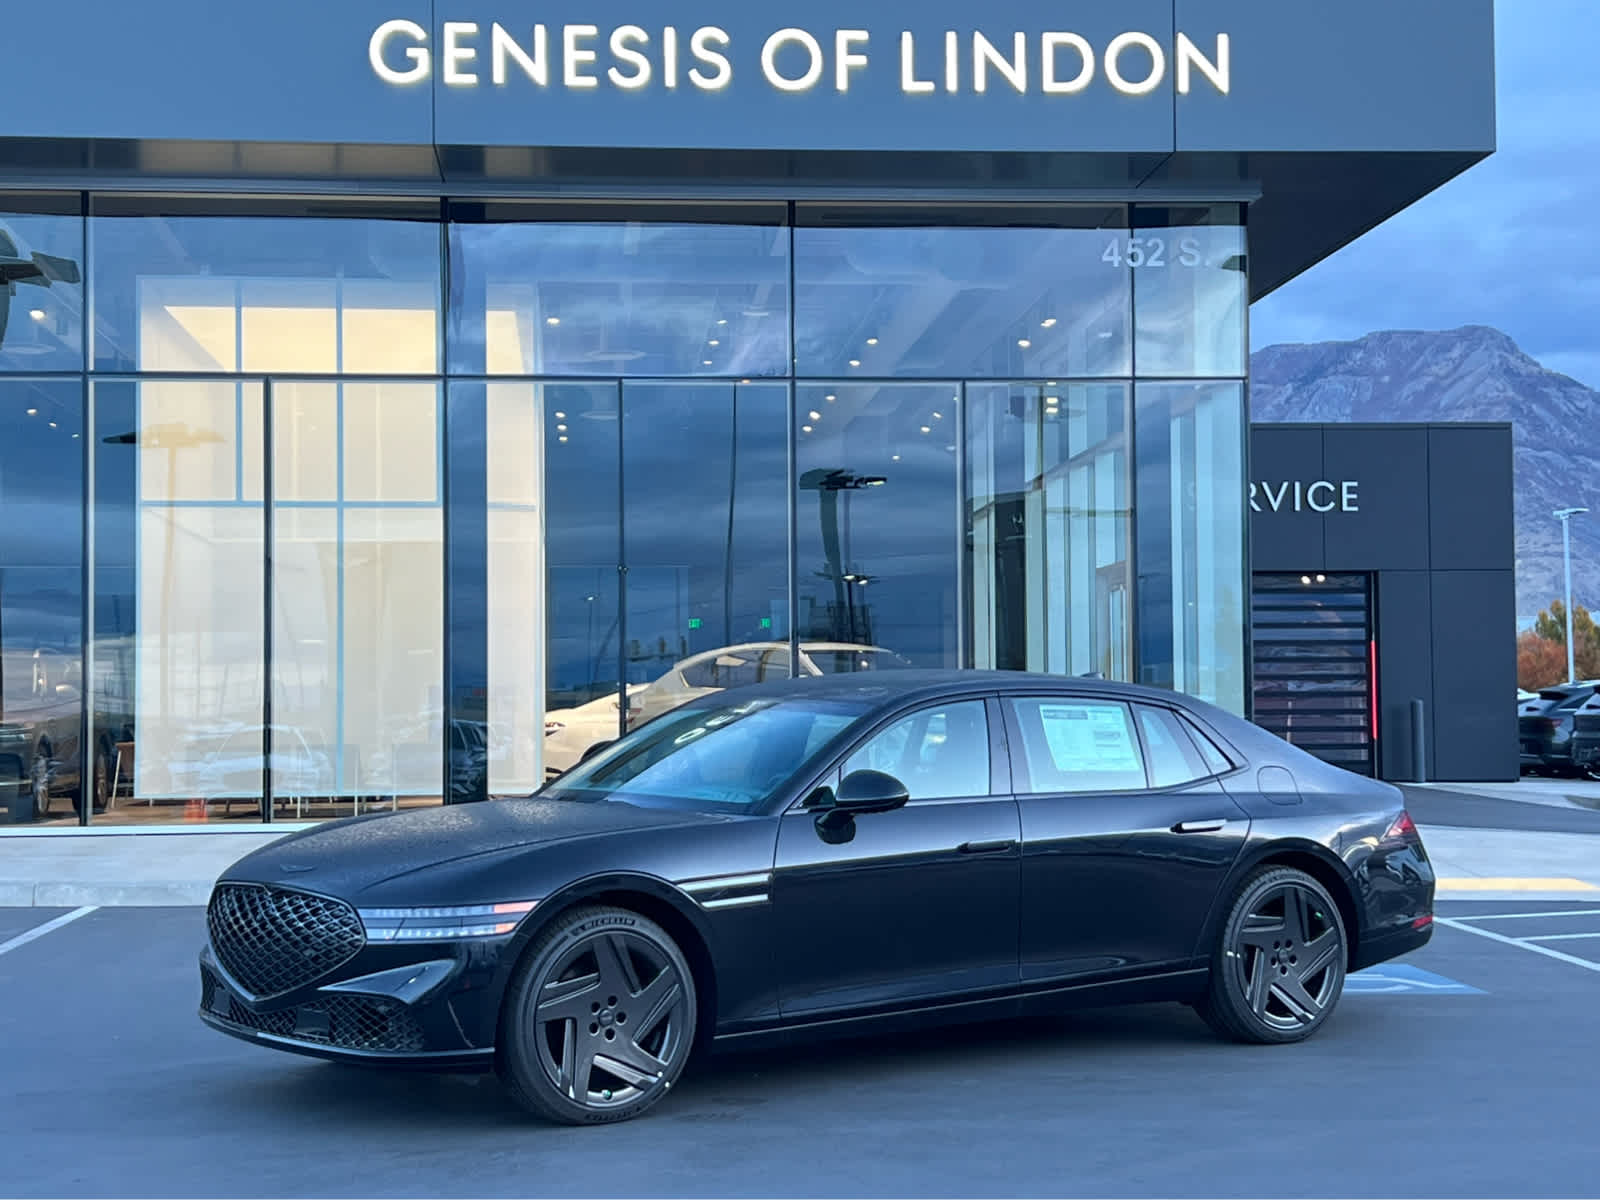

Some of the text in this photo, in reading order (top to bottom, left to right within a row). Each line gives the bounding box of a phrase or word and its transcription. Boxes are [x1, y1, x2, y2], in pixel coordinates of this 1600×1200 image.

[369, 19, 1229, 95] GENESIS OF LINDON
[1101, 238, 1165, 268] 452
[1186, 480, 1359, 512] RVICE
